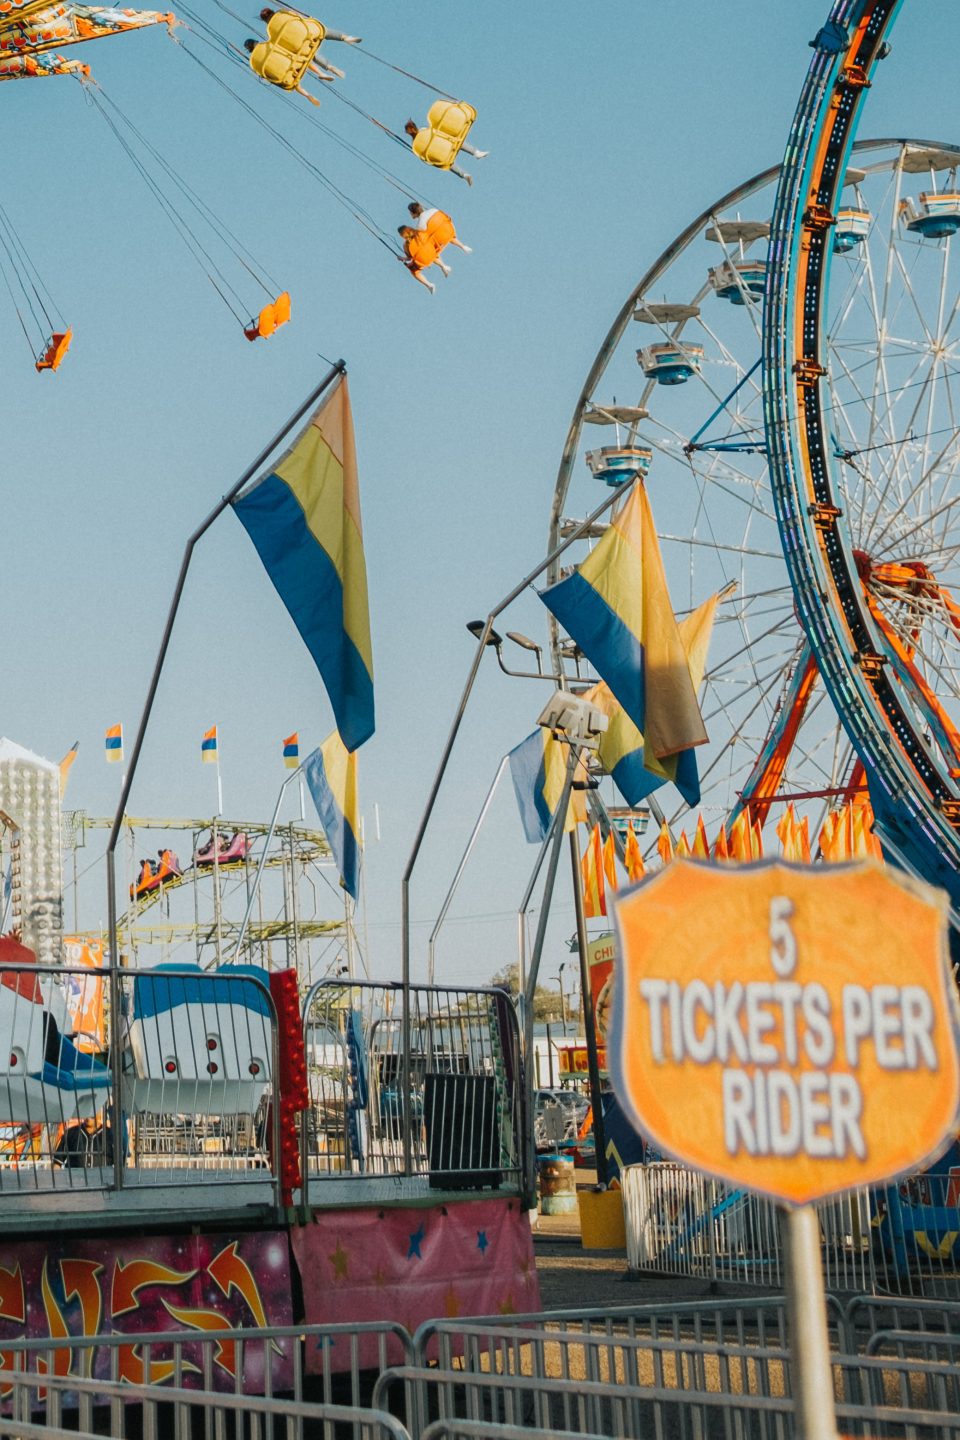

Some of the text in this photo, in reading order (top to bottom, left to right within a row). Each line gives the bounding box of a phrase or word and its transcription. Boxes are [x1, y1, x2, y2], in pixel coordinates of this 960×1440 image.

[768, 895, 798, 978] 5
[639, 978, 938, 1072] TICKETS PER
[722, 1067, 868, 1161] RIDER
